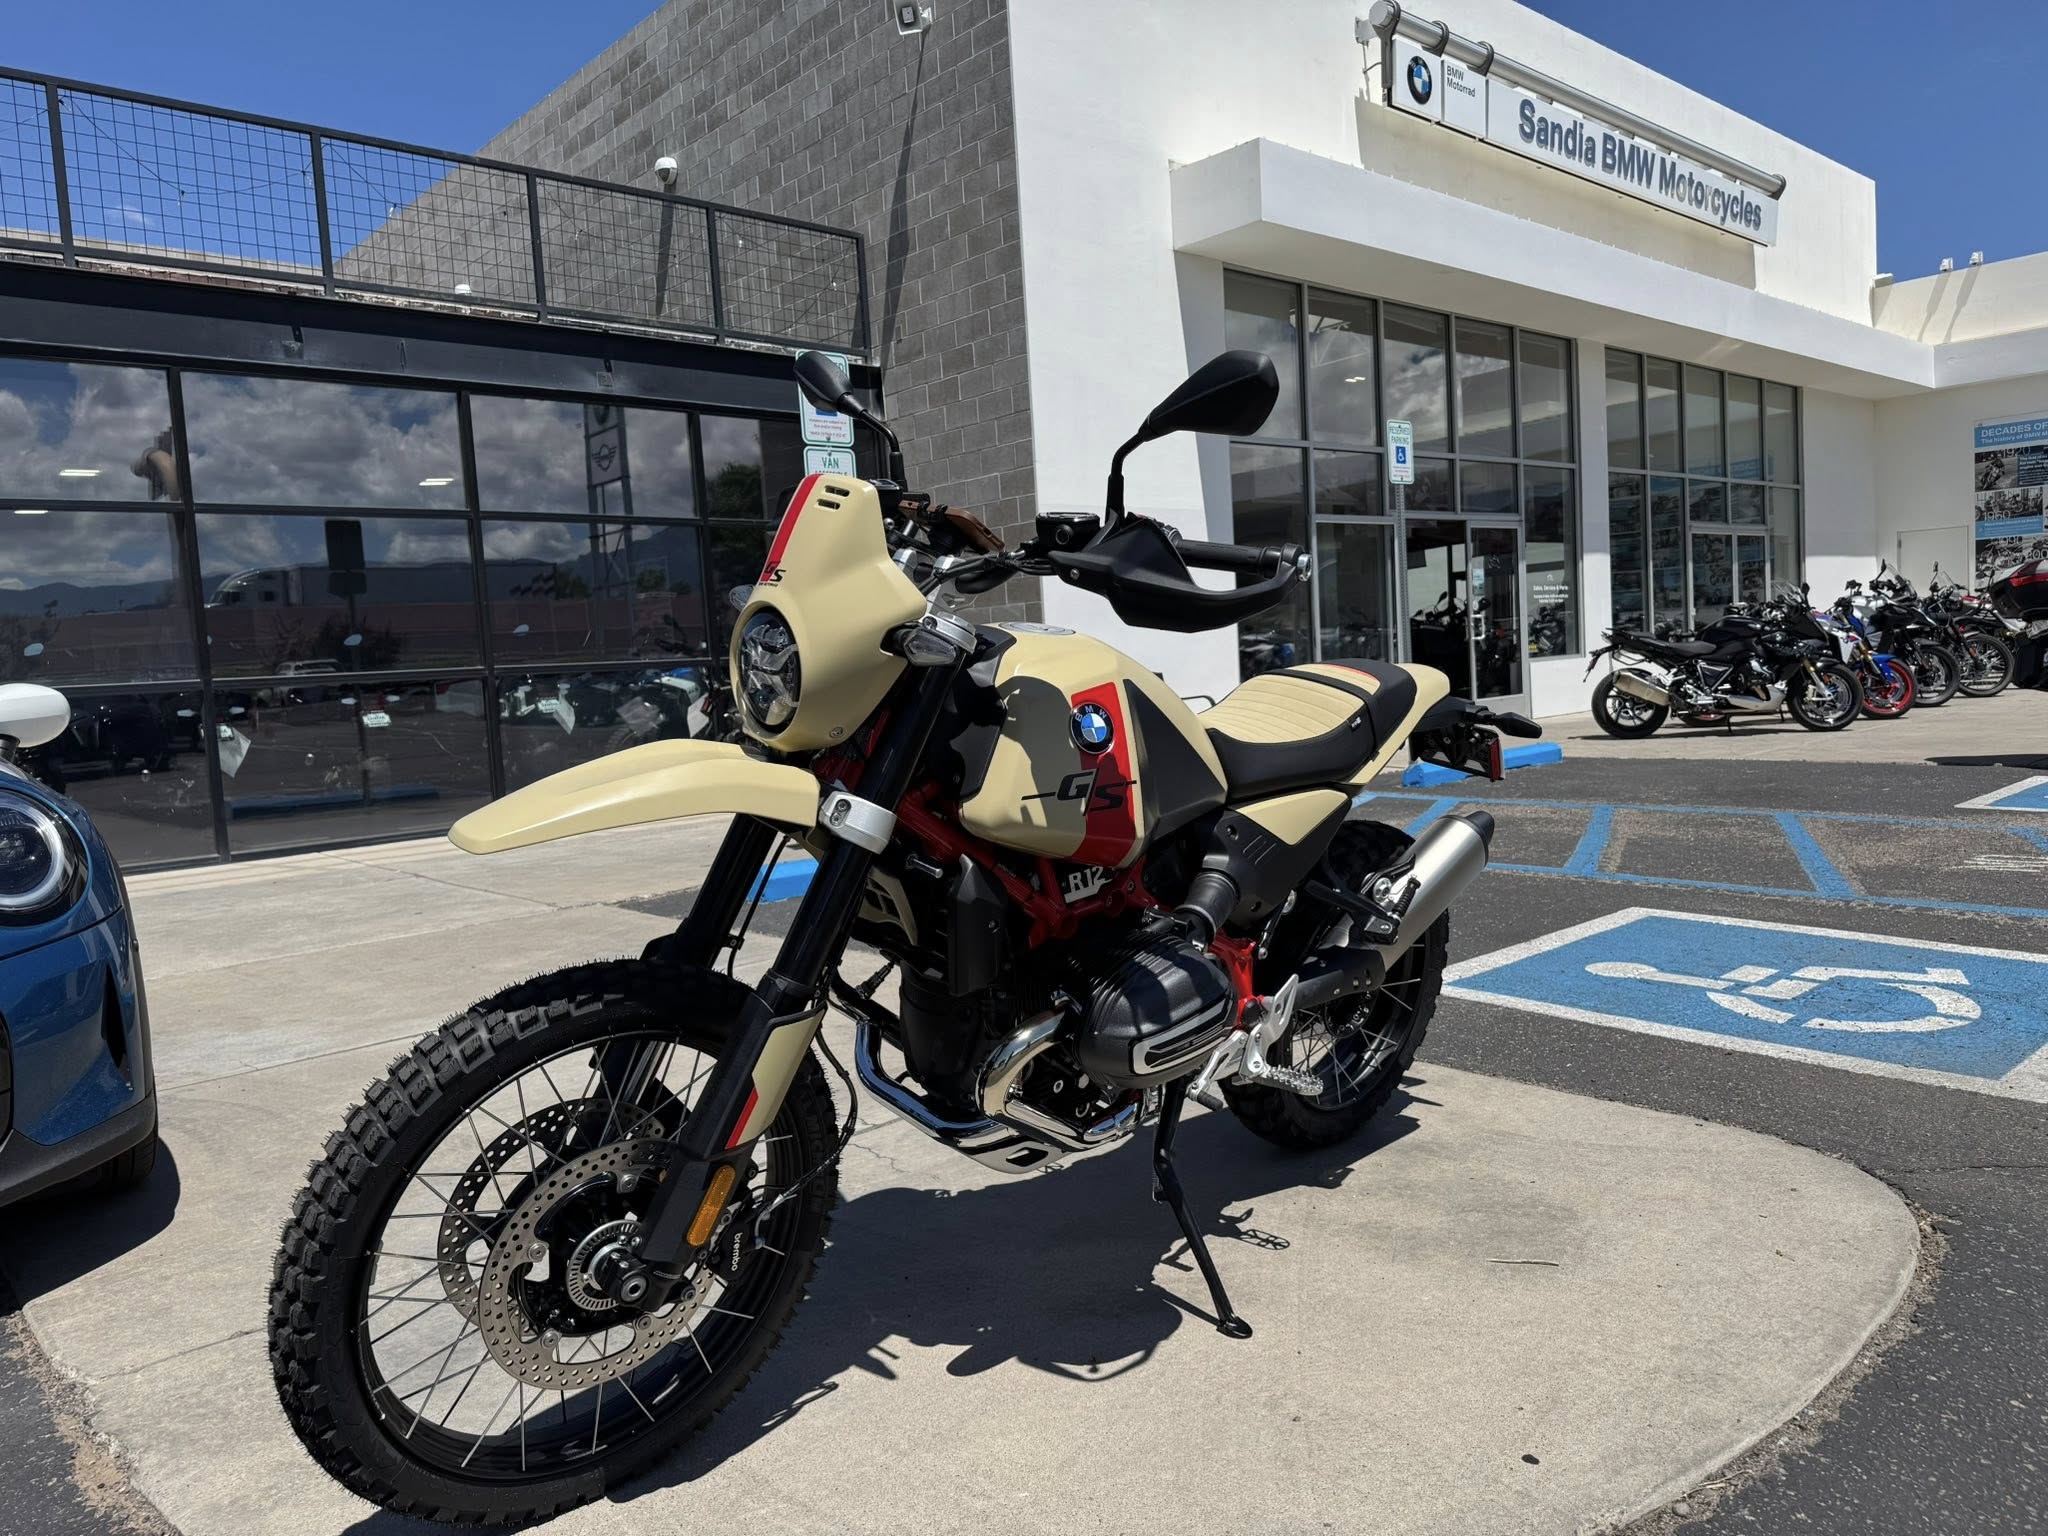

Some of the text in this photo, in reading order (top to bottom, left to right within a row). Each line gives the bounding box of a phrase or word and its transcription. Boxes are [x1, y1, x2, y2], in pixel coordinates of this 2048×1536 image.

[1447, 65, 1464, 81] BMW
[1447, 76, 1476, 97] Motorrad
[1518, 99, 1762, 231] Sandia BMW Motorcycles
[1981, 424, 2031, 437] DECADES
[821, 457, 840, 469] VAN
[1075, 705, 1107, 722] BMW
[731, 1232, 743, 1271] brembo
